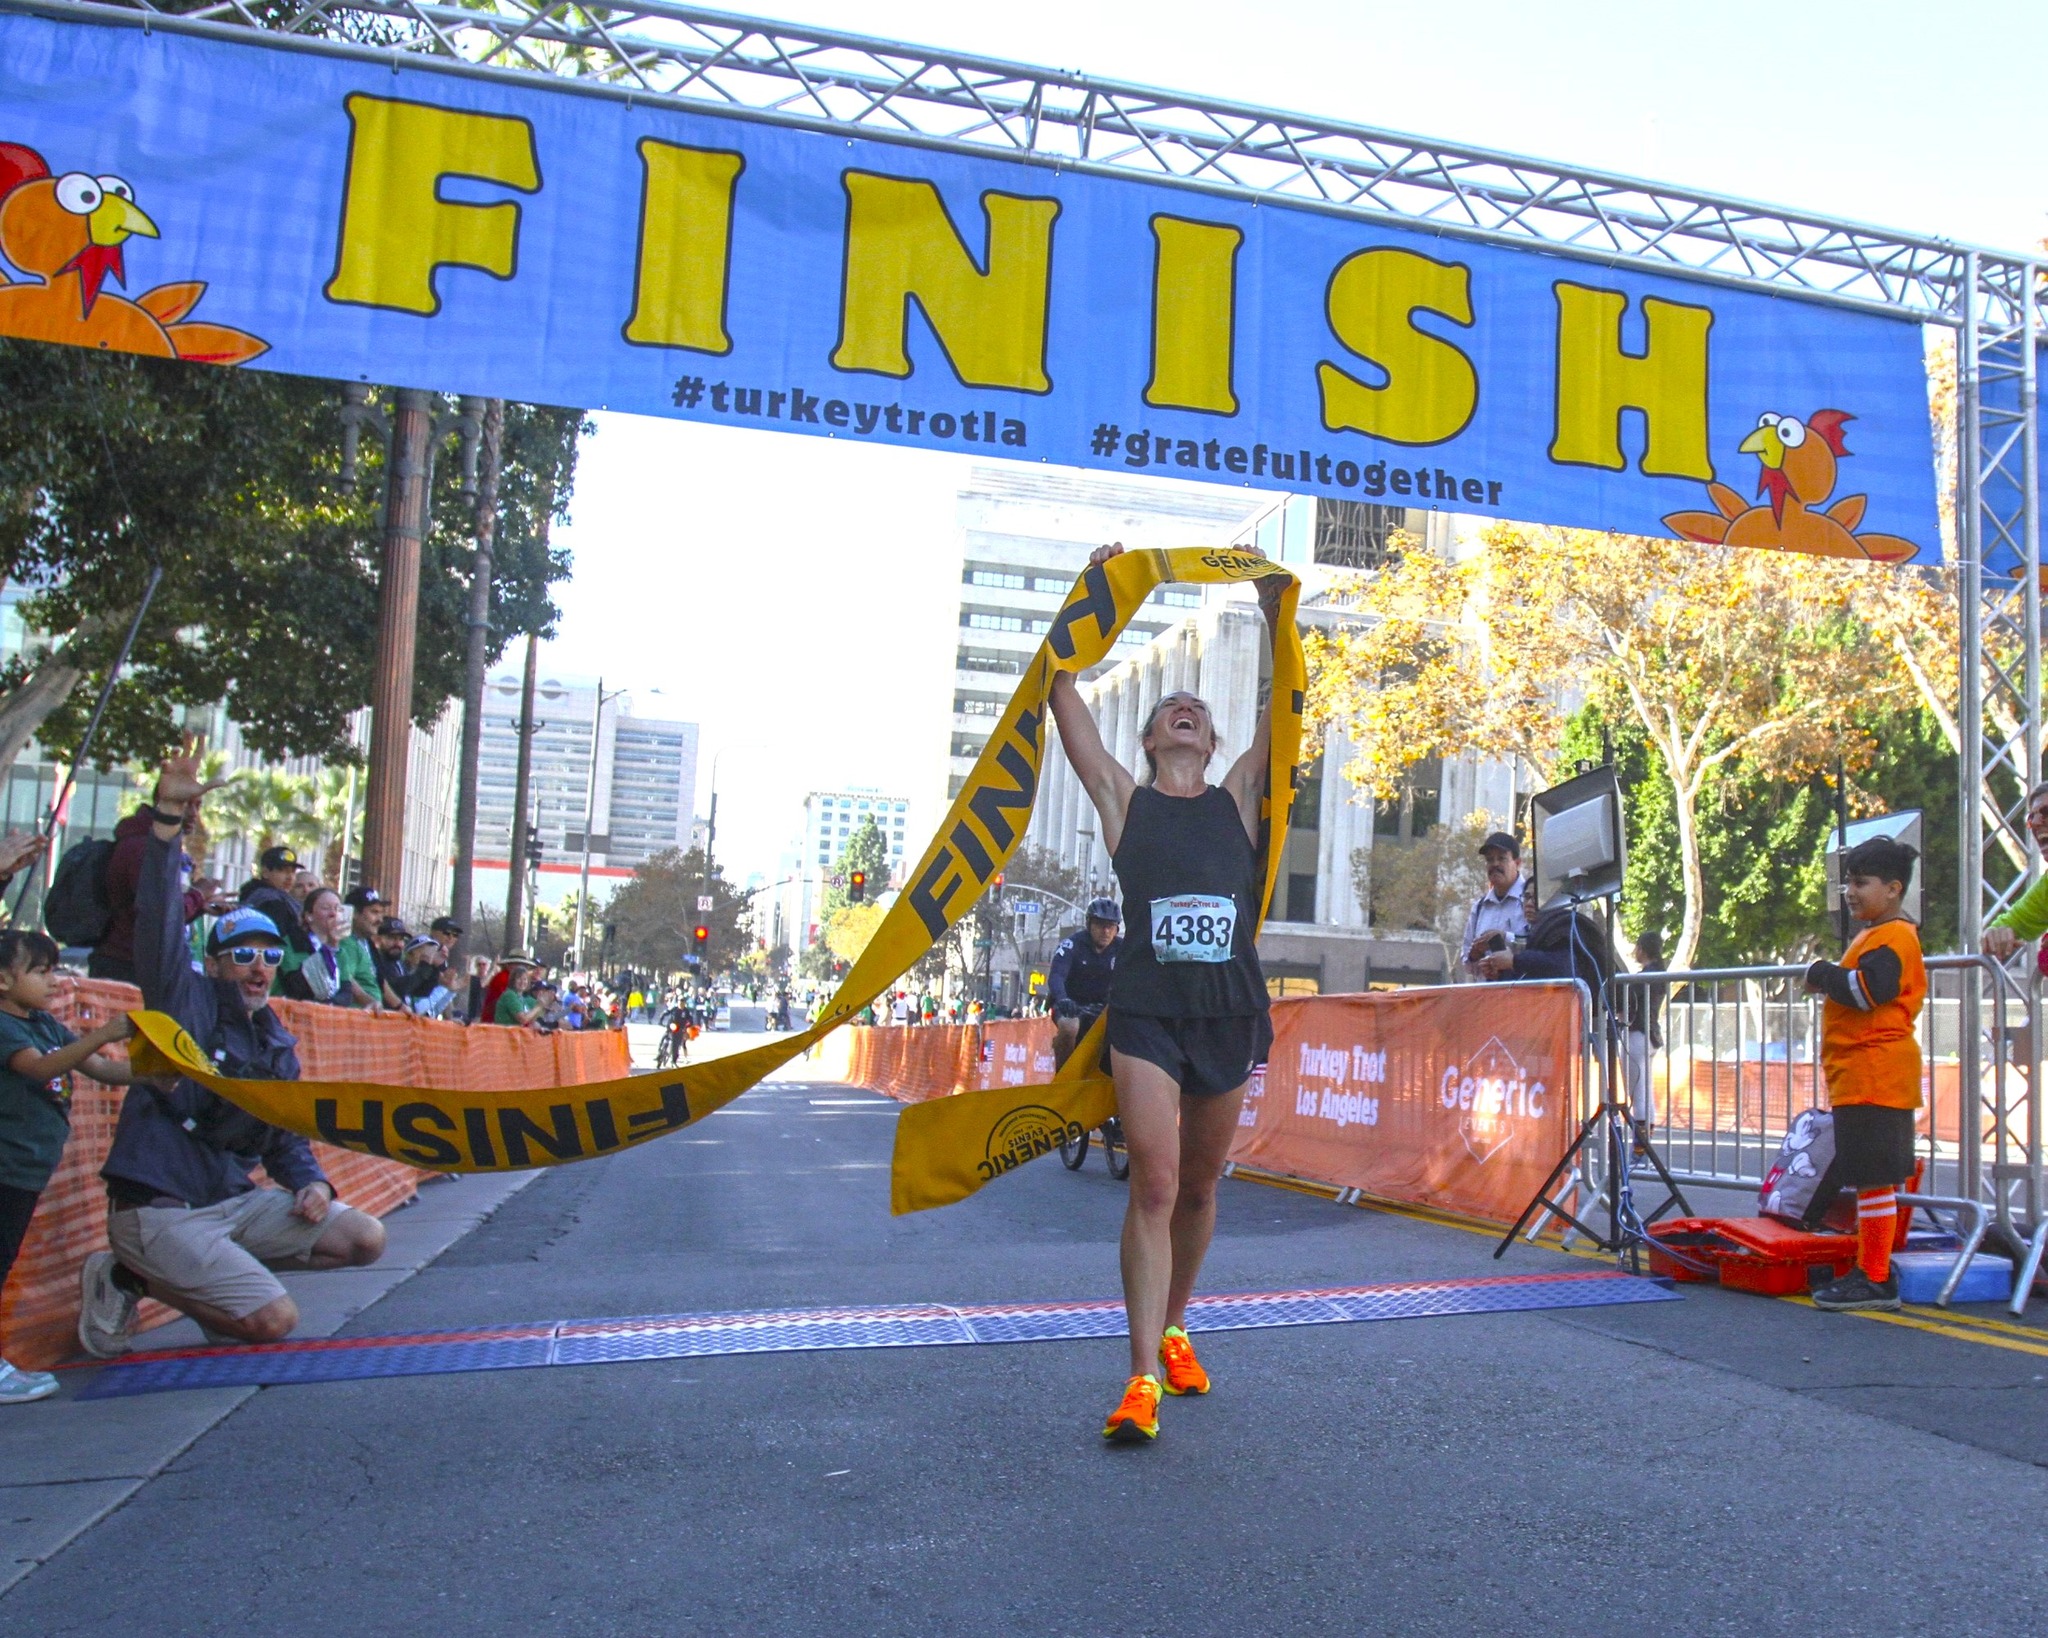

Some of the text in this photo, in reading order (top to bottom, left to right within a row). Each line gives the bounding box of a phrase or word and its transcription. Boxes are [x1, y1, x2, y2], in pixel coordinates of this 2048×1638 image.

[322, 90, 1718, 485] FINISH
[672, 374, 1029, 450] #turkeytrotla
[1090, 423, 1504, 505] #gratefultogether
[1155, 914, 1232, 948] 4383
[1298, 1042, 1387, 1085] Turkey Trot
[1441, 1065, 1546, 1119] Generic
[314, 1082, 691, 1168] FINISH
[1295, 1084, 1380, 1127] Los Angeles
[977, 1121, 1085, 1182] GENERIC
[1008, 1126, 1045, 1148] EVENTS
